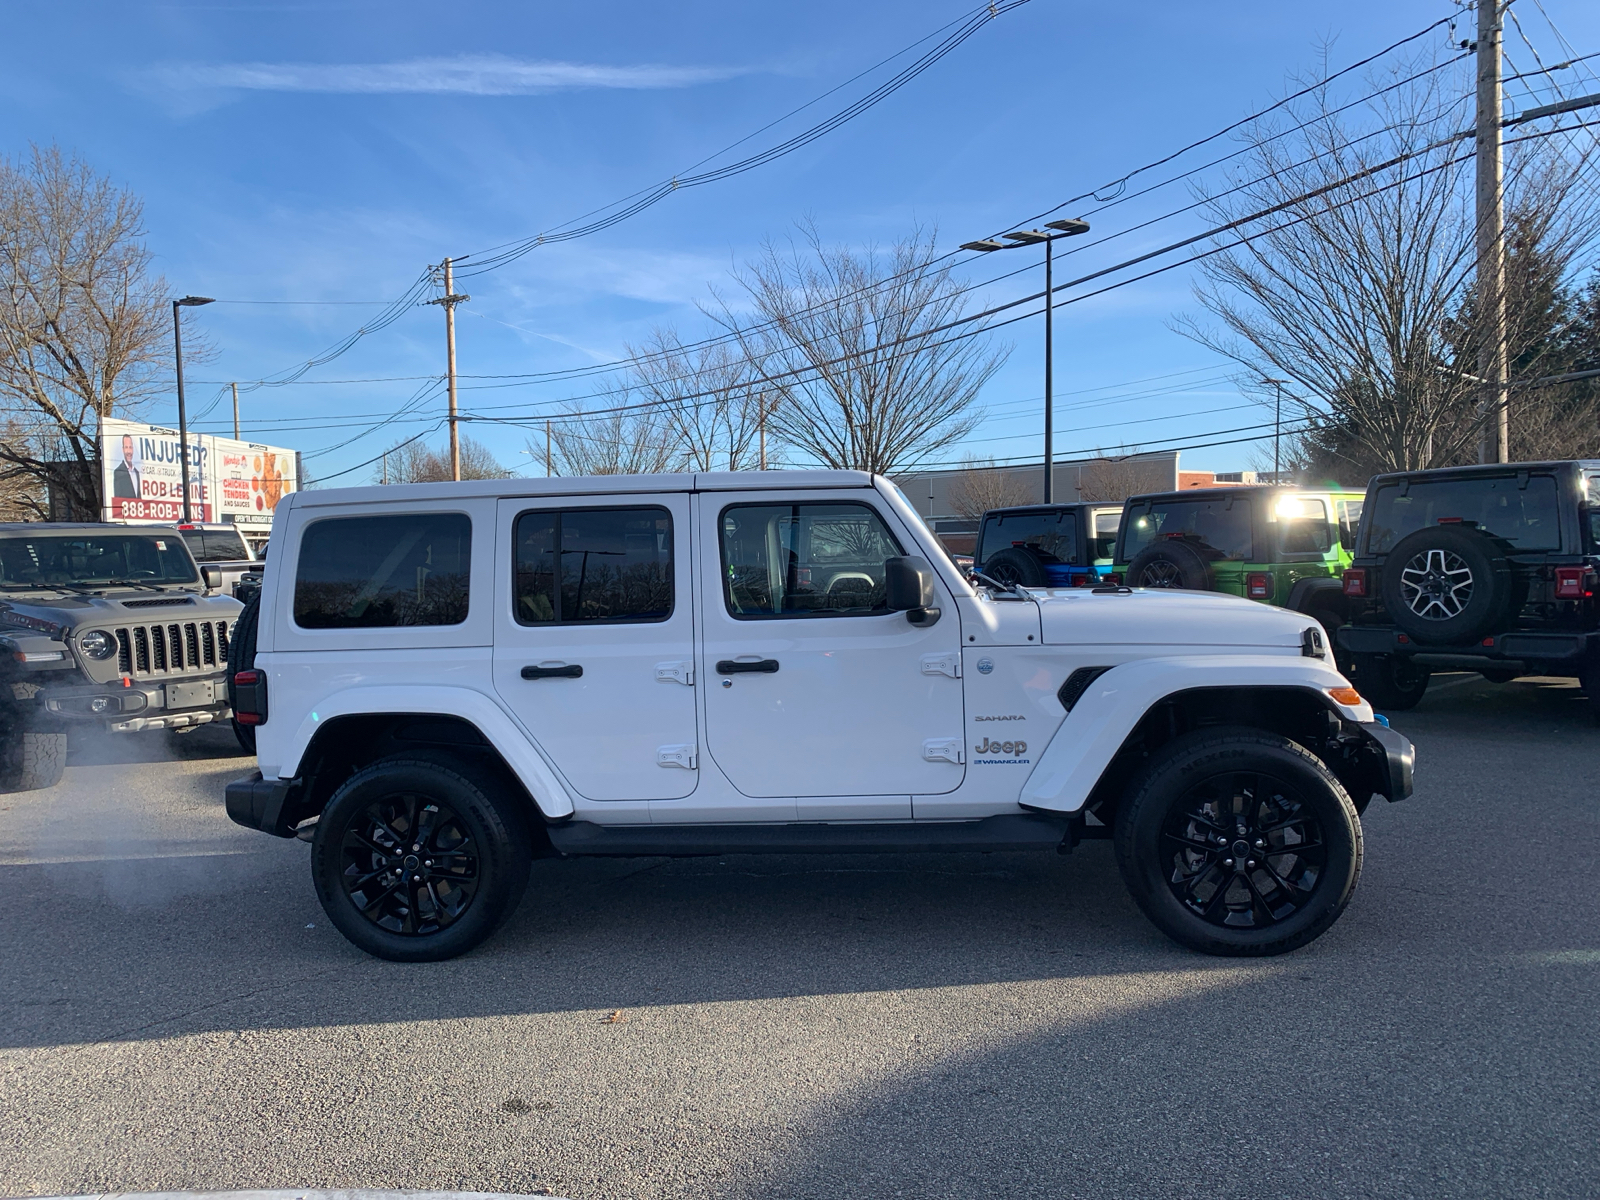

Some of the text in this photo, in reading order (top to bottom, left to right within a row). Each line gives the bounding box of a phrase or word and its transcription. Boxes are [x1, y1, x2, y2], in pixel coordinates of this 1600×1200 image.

[139, 437, 208, 468] INJURED?
[146, 466, 156, 475] CAR
[162, 467, 177, 477] TRUCK
[142, 480, 208, 500] ROB LEINE
[223, 479, 249, 490] CHICKEN
[223, 490, 250, 500] TENDERS
[122, 501, 204, 520] 888-ROB-WNS
[975, 737, 1027, 757] Jeep
